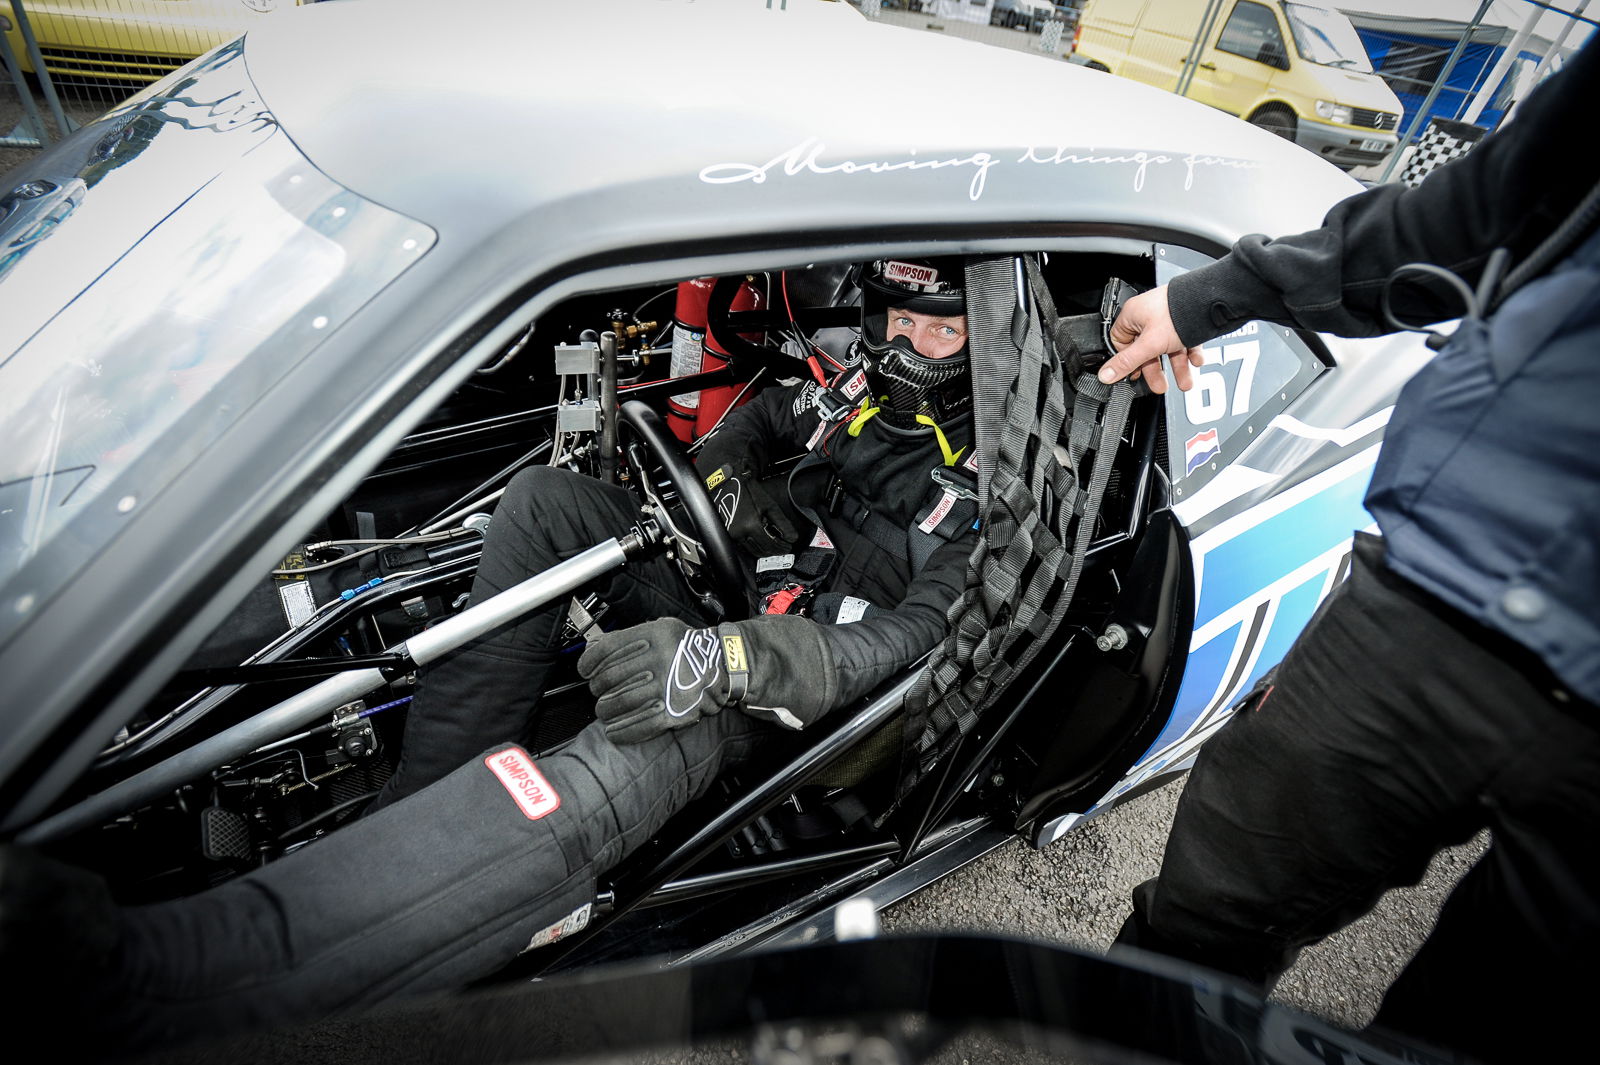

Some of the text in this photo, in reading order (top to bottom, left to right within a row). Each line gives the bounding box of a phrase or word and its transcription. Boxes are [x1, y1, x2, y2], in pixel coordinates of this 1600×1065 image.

[699, 134, 1000, 201] Moving
[1017, 145, 1172, 192] things
[889, 263, 932, 282] SIMPSON
[1184, 340, 1261, 425] 67
[928, 498, 951, 526] SIMPSON
[499, 755, 547, 805] SIMPSON
